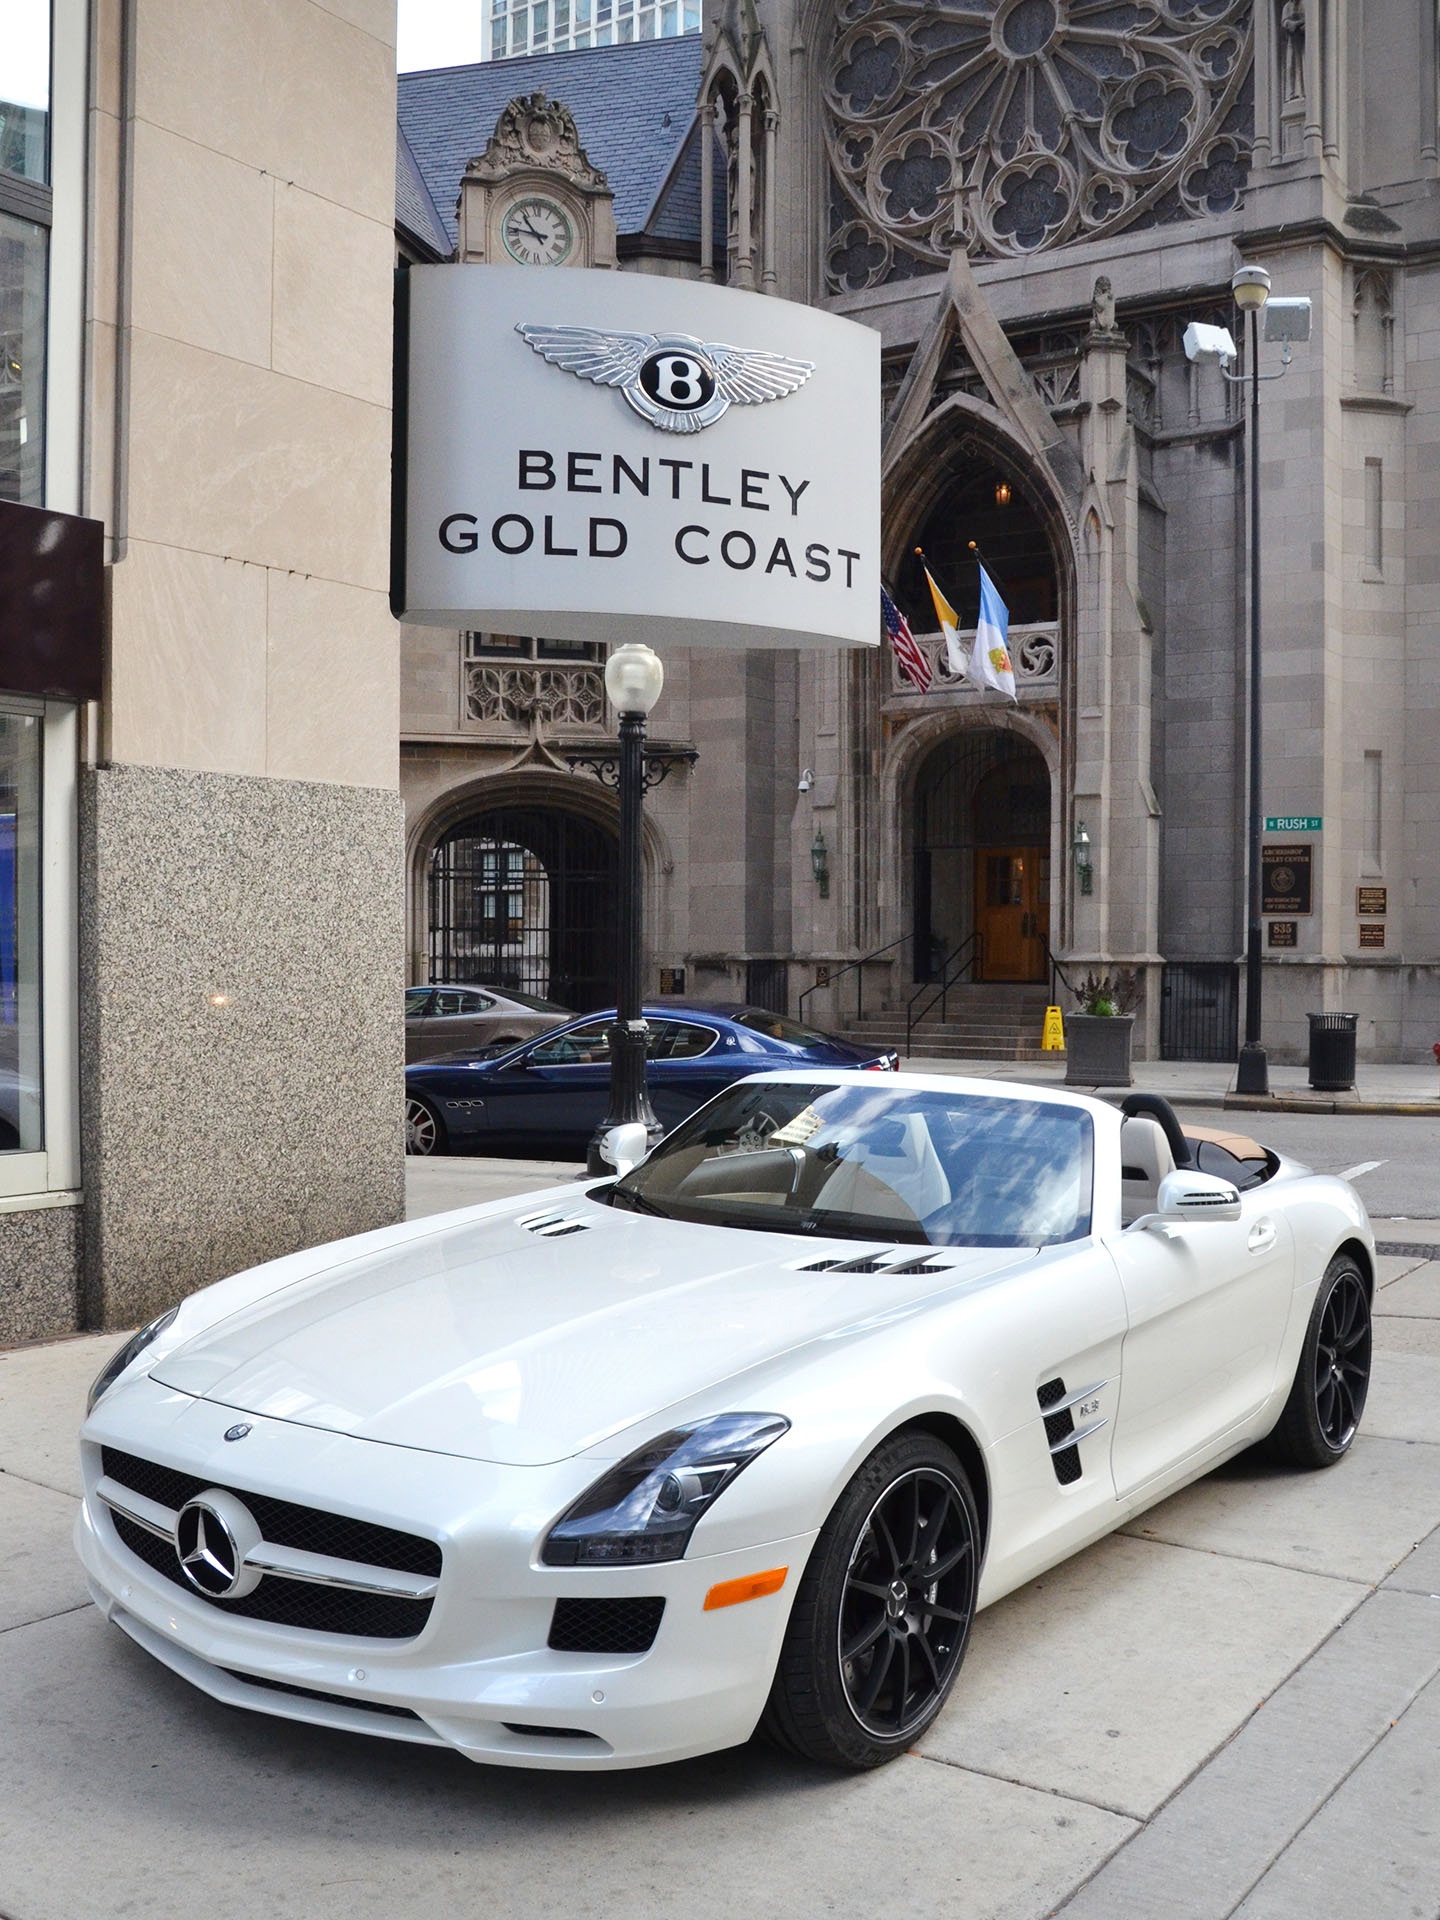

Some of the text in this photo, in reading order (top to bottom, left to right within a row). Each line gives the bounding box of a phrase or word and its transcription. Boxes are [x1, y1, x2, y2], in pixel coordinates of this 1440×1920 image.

[518, 449, 811, 516] BENTLEY
[438, 513, 861, 588] GOLD COAST
[1277, 818, 1308, 829] RUSH
[1311, 819, 1318, 827] ST
[1273, 923, 1291, 934] 835
